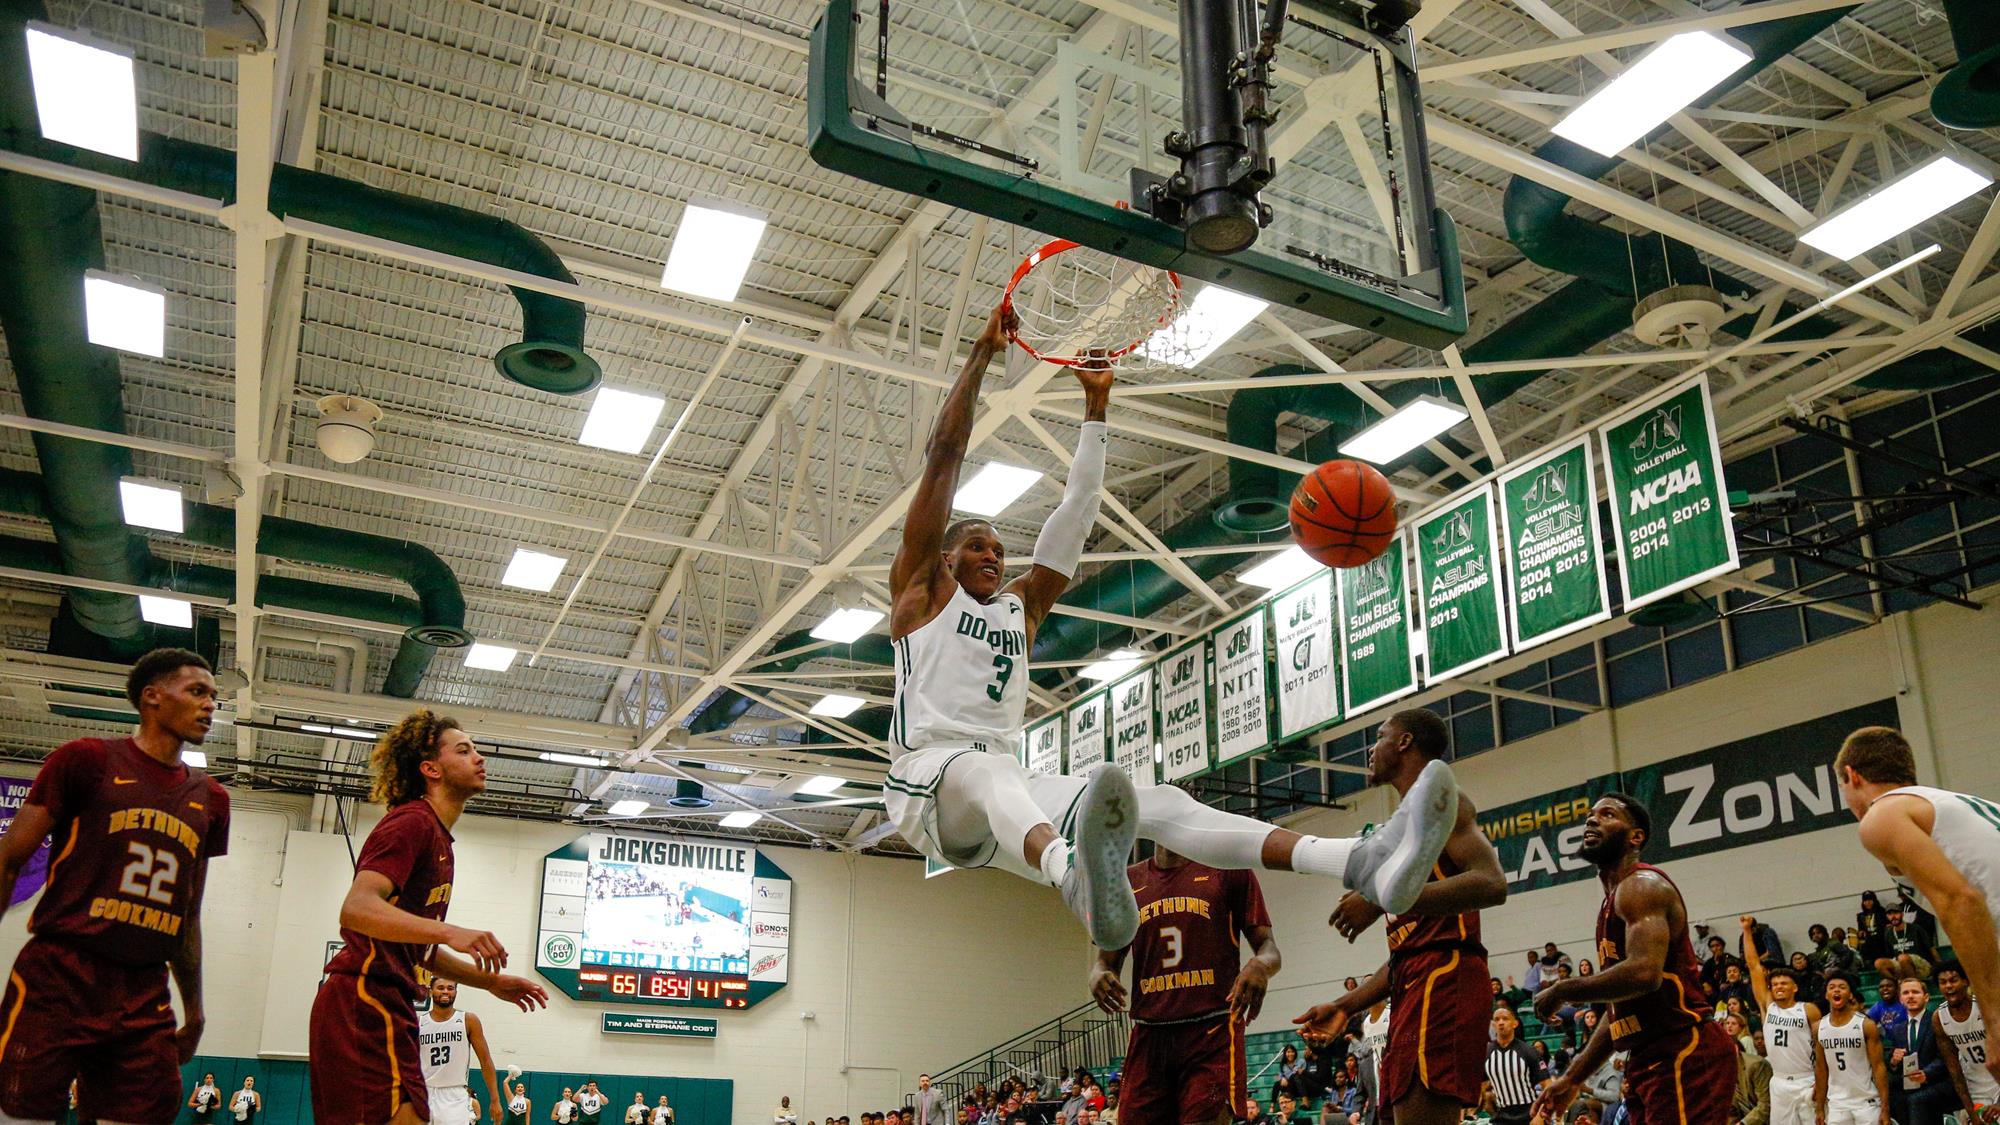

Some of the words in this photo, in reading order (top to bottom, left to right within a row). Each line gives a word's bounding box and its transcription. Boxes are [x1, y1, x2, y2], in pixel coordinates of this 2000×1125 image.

[1634, 444, 1687, 475] VOLLEYBALL
[1630, 460, 1702, 516] NCAA
[1525, 500, 1571, 525] VOLLEYBALL
[1630, 517, 1667, 544] 2004
[1672, 497, 1711, 525] 2013
[1518, 524, 1584, 560] TOURNAMENT
[1520, 535, 1585, 572] CHAMPIONS
[1632, 534, 1669, 560] 2014
[1435, 544, 1475, 568] VOLLEYBALL
[1520, 567, 1551, 590] 2004
[1556, 550, 1588, 573] 2013
[1356, 585, 1390, 606] VOLLEYBALL
[1429, 573, 1488, 609] CHAMPIONS
[1521, 582, 1552, 605] 2014
[1350, 612, 1401, 644] CHAMPIONS
[1430, 607, 1458, 629] 2013
[1352, 643, 1375, 661] 1989
[986, 654, 1014, 703] 3
[1223, 667, 1258, 699] NIT
[1285, 676, 1304, 693] 2011
[1308, 665, 1328, 682] 2017
[1167, 698, 1199, 727] NCAA
[1222, 705, 1239, 719] 1972
[1118, 720, 1147, 748] NCAA
[1166, 726, 1183, 740] FINAL
[1185, 717, 1201, 731] FOUR
[1222, 728, 1240, 742] 2009
[1243, 718, 1262, 734] 2010
[1168, 741, 1200, 768] 1970
[1480, 797, 1591, 840] WISHER
[1664, 763, 1851, 848] ZON
[108, 808, 199, 859] BETHUNE
[600, 837, 746, 873] JACKSONVILLE
[119, 840, 179, 904] 22
[89, 897, 182, 936] COOKMAN
[1139, 897, 1211, 924] ETHUNE
[1160, 926, 1183, 969] 3
[613, 975, 635, 994] 65
[651, 977, 689, 996] 8:54
[697, 981, 719, 998] 41
[1140, 969, 1215, 995] COOKMAN
[624, 1021, 642, 1029] AND
[645, 1022, 690, 1031] STEPHANIE
[1767, 1014, 1804, 1029] DOLPHINS
[1774, 1029, 1789, 1047] 21
[430, 1046, 450, 1066] 23
[1836, 1052, 1846, 1071] 5
[1967, 1045, 1986, 1064] 13
